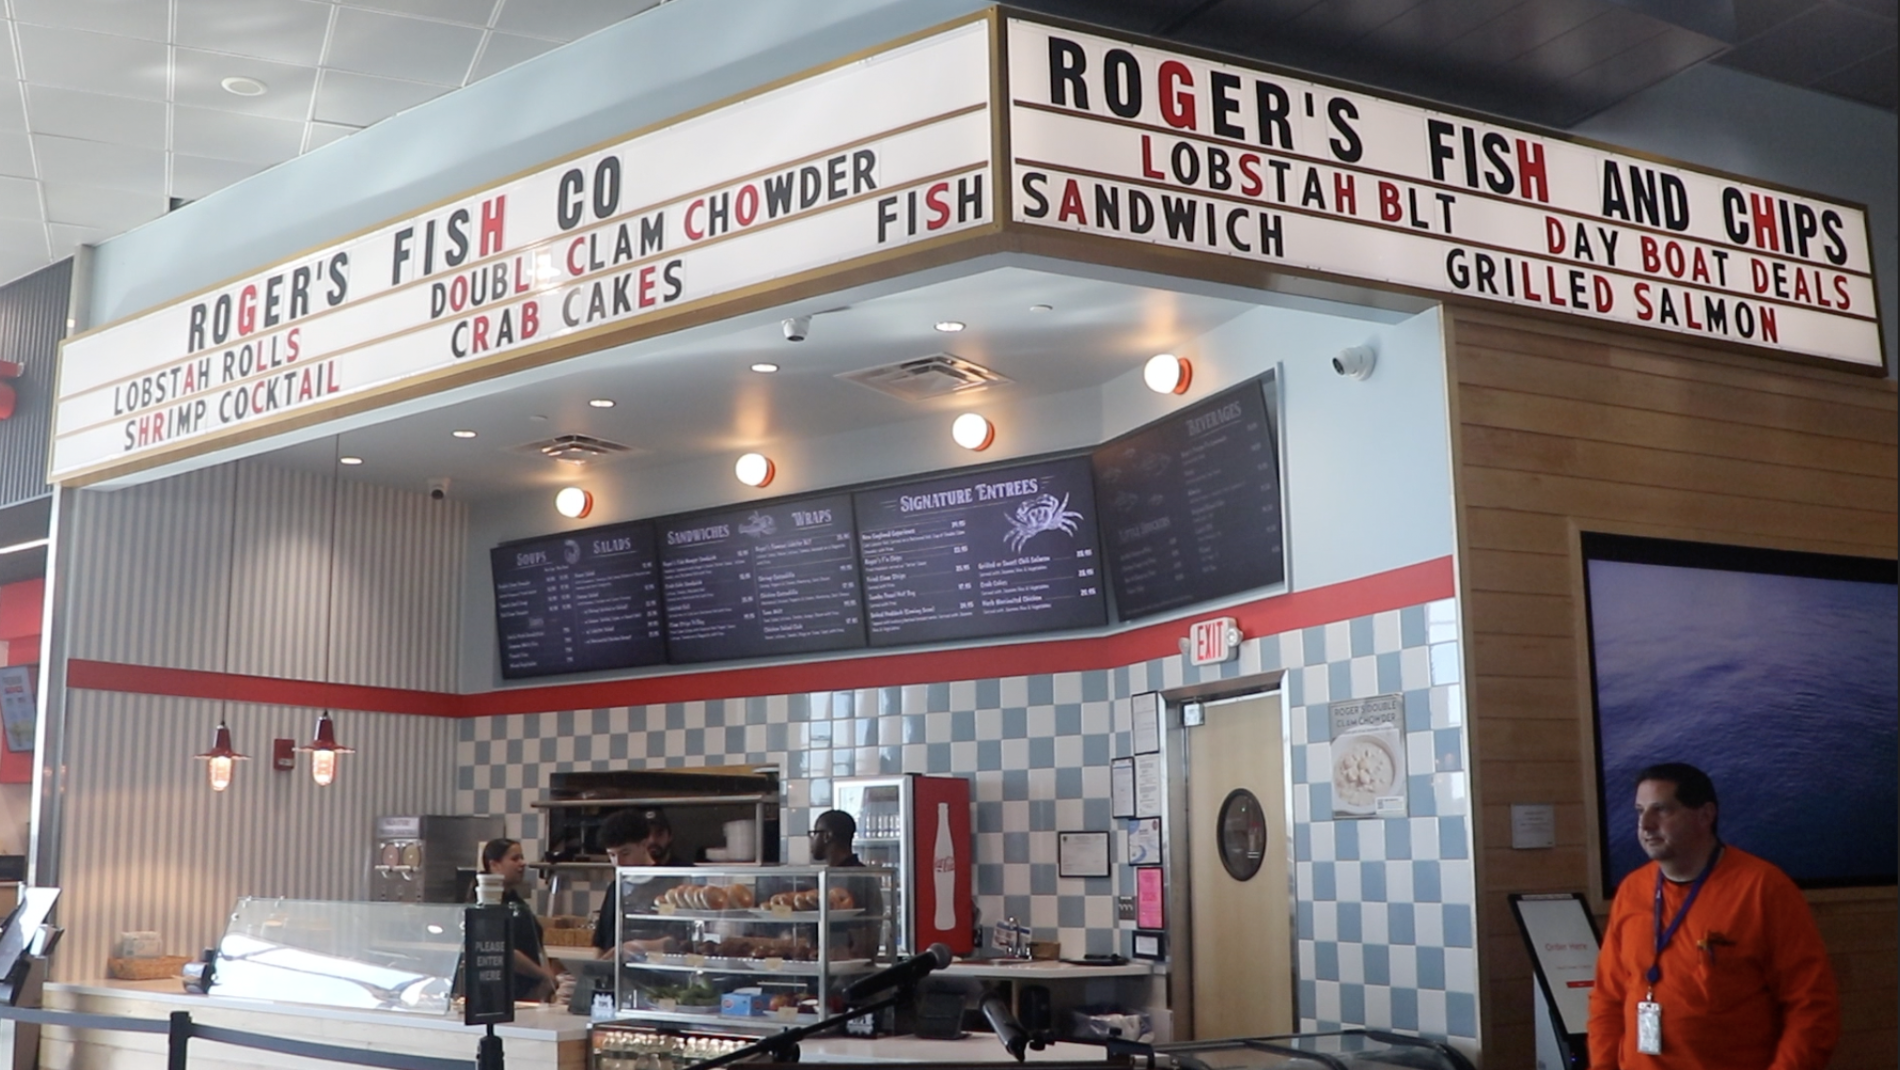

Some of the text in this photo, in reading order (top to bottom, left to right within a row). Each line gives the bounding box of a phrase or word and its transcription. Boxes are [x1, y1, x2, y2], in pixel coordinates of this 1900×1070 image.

[1048, 36, 1849, 266] ROGER'S FISH AND CHIPS
[1141, 135, 1456, 234] LOBSTAH BLT
[188, 155, 621, 354] ROGER'S FISH CO
[431, 149, 878, 320] DOUBL CLAM CHOWDER
[878, 175, 983, 244] FISH
[1022, 172, 1285, 257] SANDWICH
[451, 260, 683, 359] CRAB CAKES
[1446, 248, 1779, 344] GRILLED SALMON
[1545, 216, 1851, 311] DAY BOAT DEALS
[114, 328, 300, 416] LOBSTAH ROLLS
[124, 361, 340, 451] SHRIMP COCKTAIL
[1197, 621, 1223, 660] EXIT
[475, 941, 505, 952] PLEASE
[477, 955, 503, 967] ENTER
